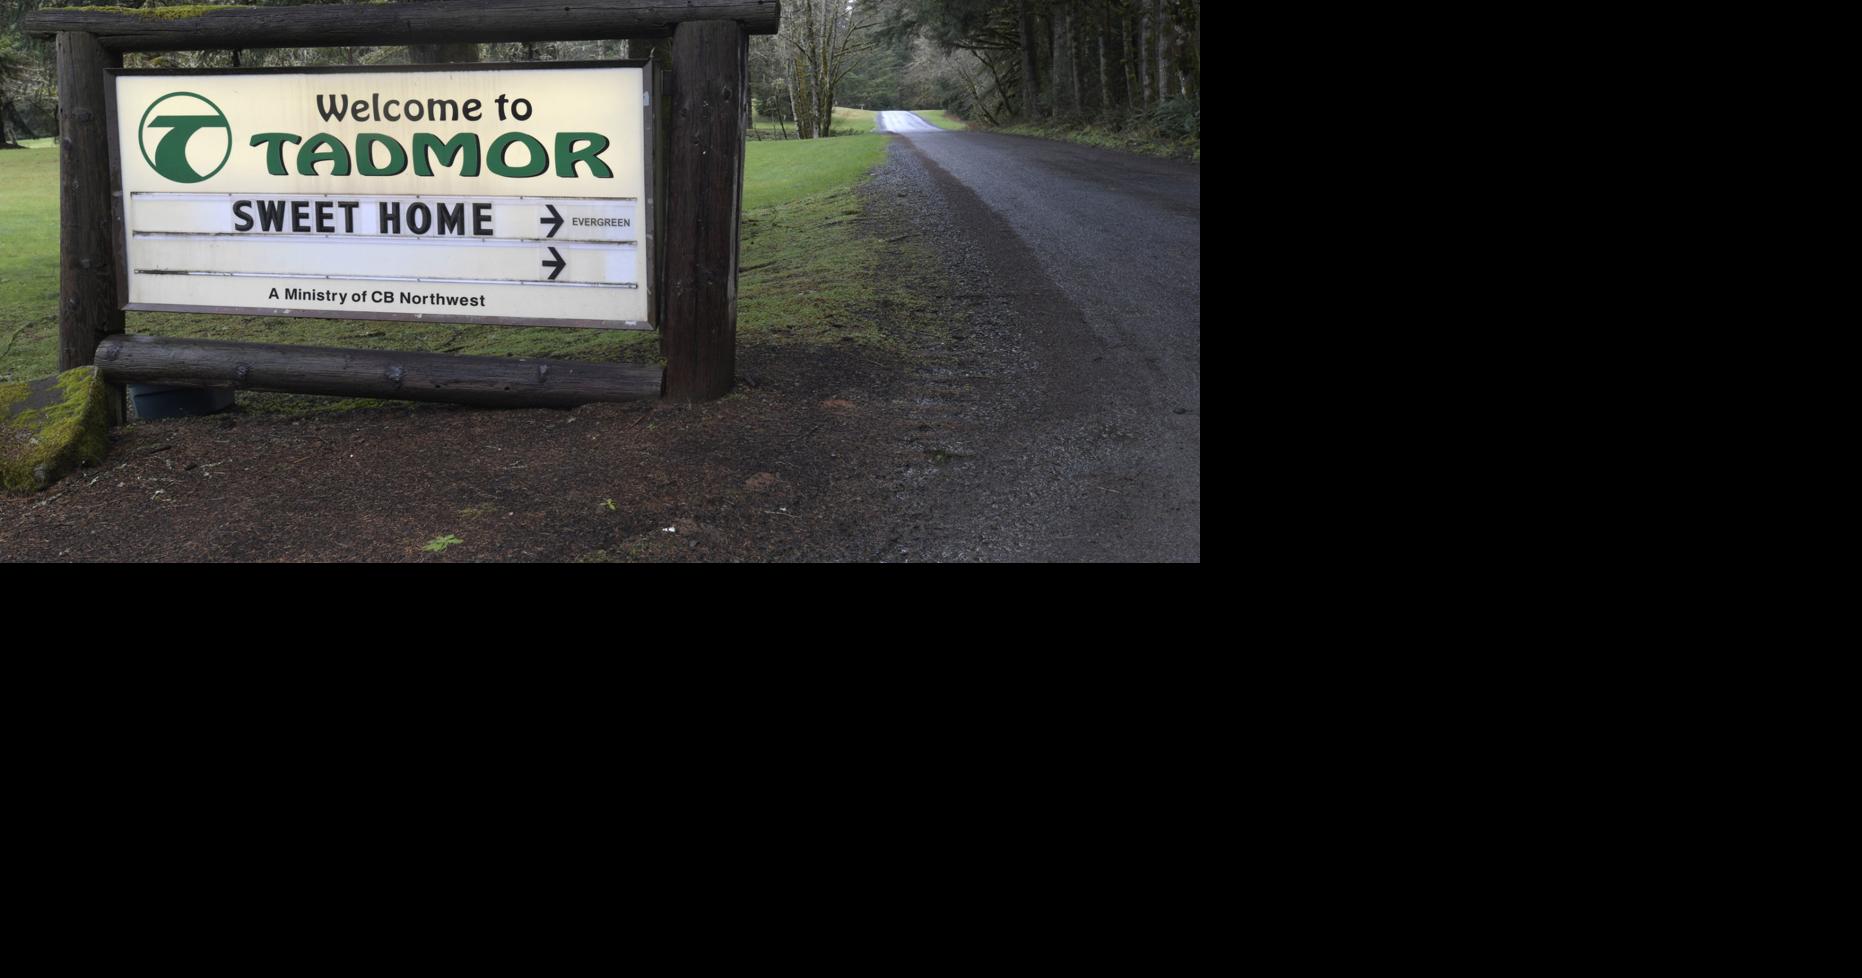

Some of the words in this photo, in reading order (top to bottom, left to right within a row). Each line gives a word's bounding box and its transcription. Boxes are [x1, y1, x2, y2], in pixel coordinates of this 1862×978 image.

[316, 92, 483, 123] Welcome
[494, 93, 533, 122] to
[249, 131, 615, 179] TADMOR
[232, 200, 360, 233] SWEET
[379, 201, 494, 236] HOME
[572, 217, 631, 227] EVERGREEN
[268, 287, 280, 300] A
[284, 287, 348, 305] Ministry
[351, 290, 368, 303] of
[371, 290, 395, 304] CB
[399, 291, 486, 307] Northwest
